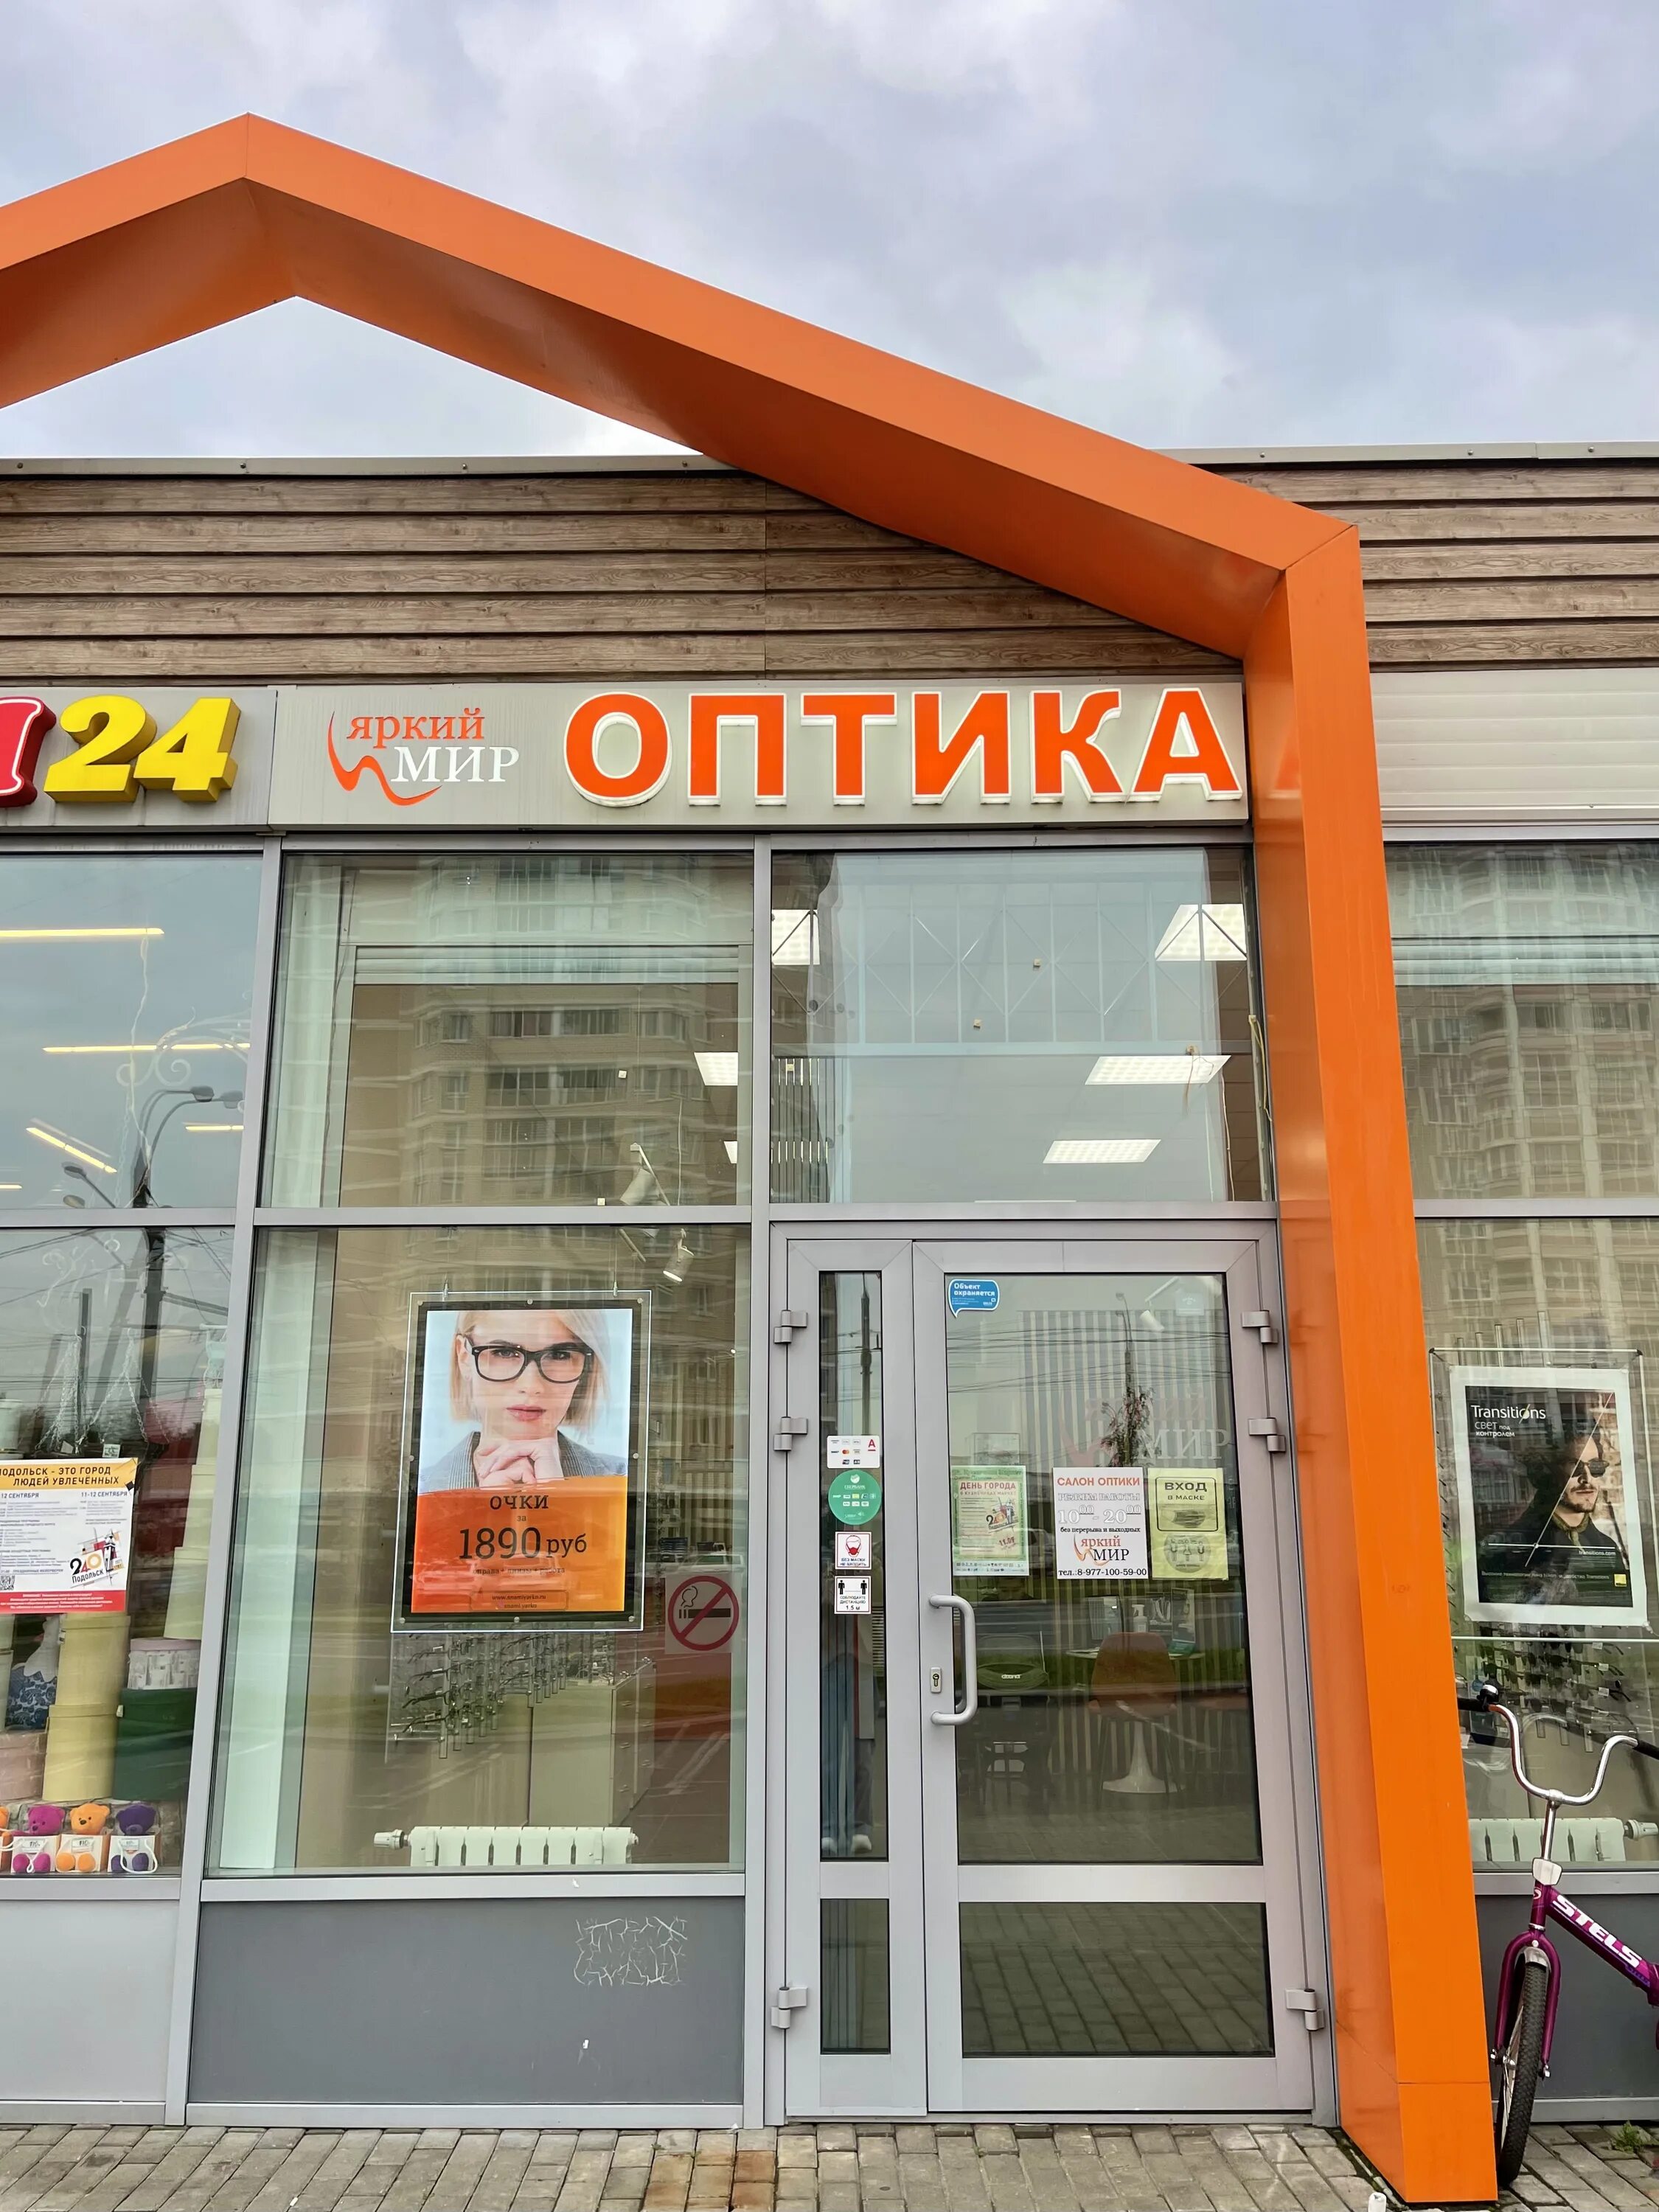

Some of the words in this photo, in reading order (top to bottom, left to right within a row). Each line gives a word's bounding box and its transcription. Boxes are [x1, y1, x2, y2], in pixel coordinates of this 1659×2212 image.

[347, 708, 485, 748] яркий
[44, 695, 242, 803] 24
[563, 687, 1243, 807] ОПТИКА
[392, 746, 520, 783] МИР
[1470, 1404, 1546, 1420] Transitions
[58, 1467, 77, 1475] ЭТО
[80, 1467, 111, 1475] ГОРОД
[13, 1475, 49, 1486] ЛЮДЕЙ
[52, 1476, 119, 1486] УВЛЕЧЁННЫХ
[960, 1482, 982, 1490] ДЕНЬ
[984, 1482, 1016, 1490] ГОРОДА
[1057, 1477, 1094, 1486] САЛОН
[1098, 1477, 1140, 1486] ОПТИКИ
[1164, 1482, 1208, 1492] ВХОД
[459, 1527, 541, 1559] 1890
[546, 1533, 587, 1558] руб
[1081, 1535, 1121, 1549] яркий
[1093, 1548, 1130, 1561] МИР
[1552, 1894, 1643, 1968] STELS
